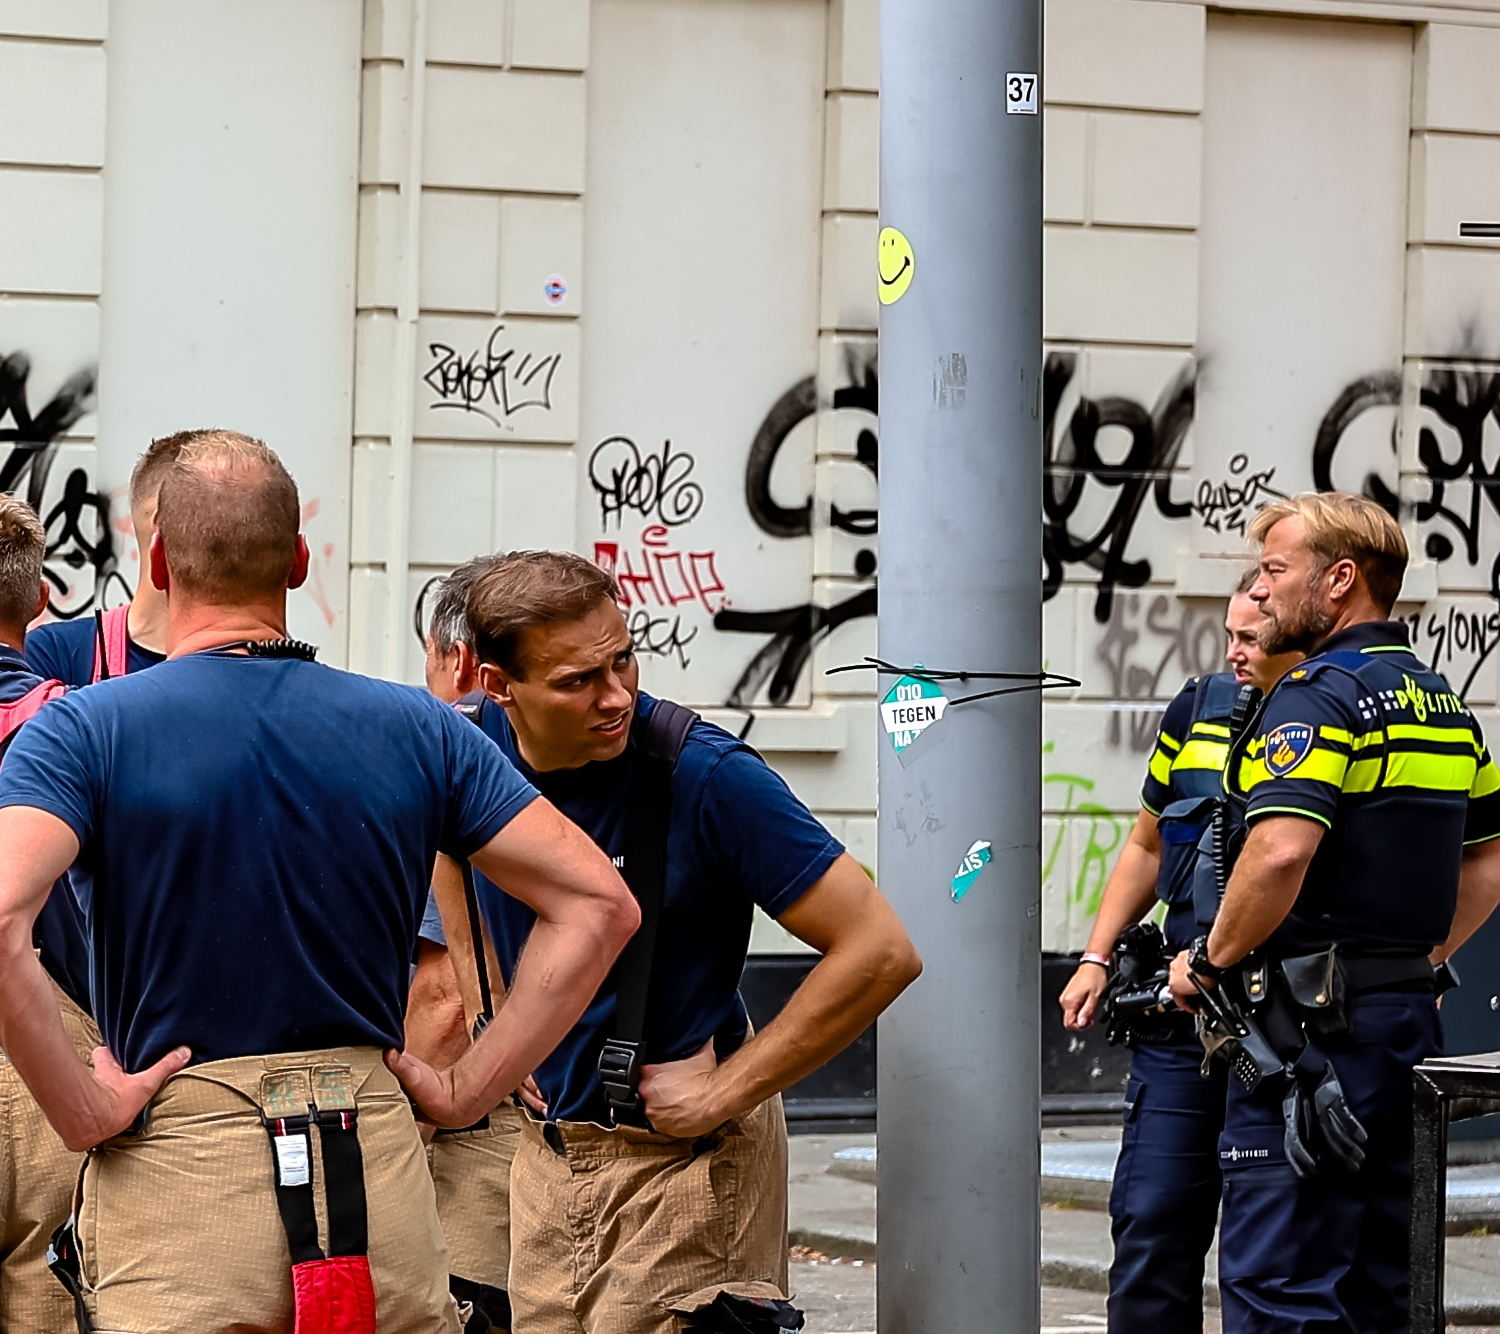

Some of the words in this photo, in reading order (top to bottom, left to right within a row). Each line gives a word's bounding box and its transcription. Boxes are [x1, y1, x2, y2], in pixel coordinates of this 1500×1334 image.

[1008, 77, 1035, 102] 37
[896, 683, 922, 702] 010
[892, 705, 936, 724] TEGEN
